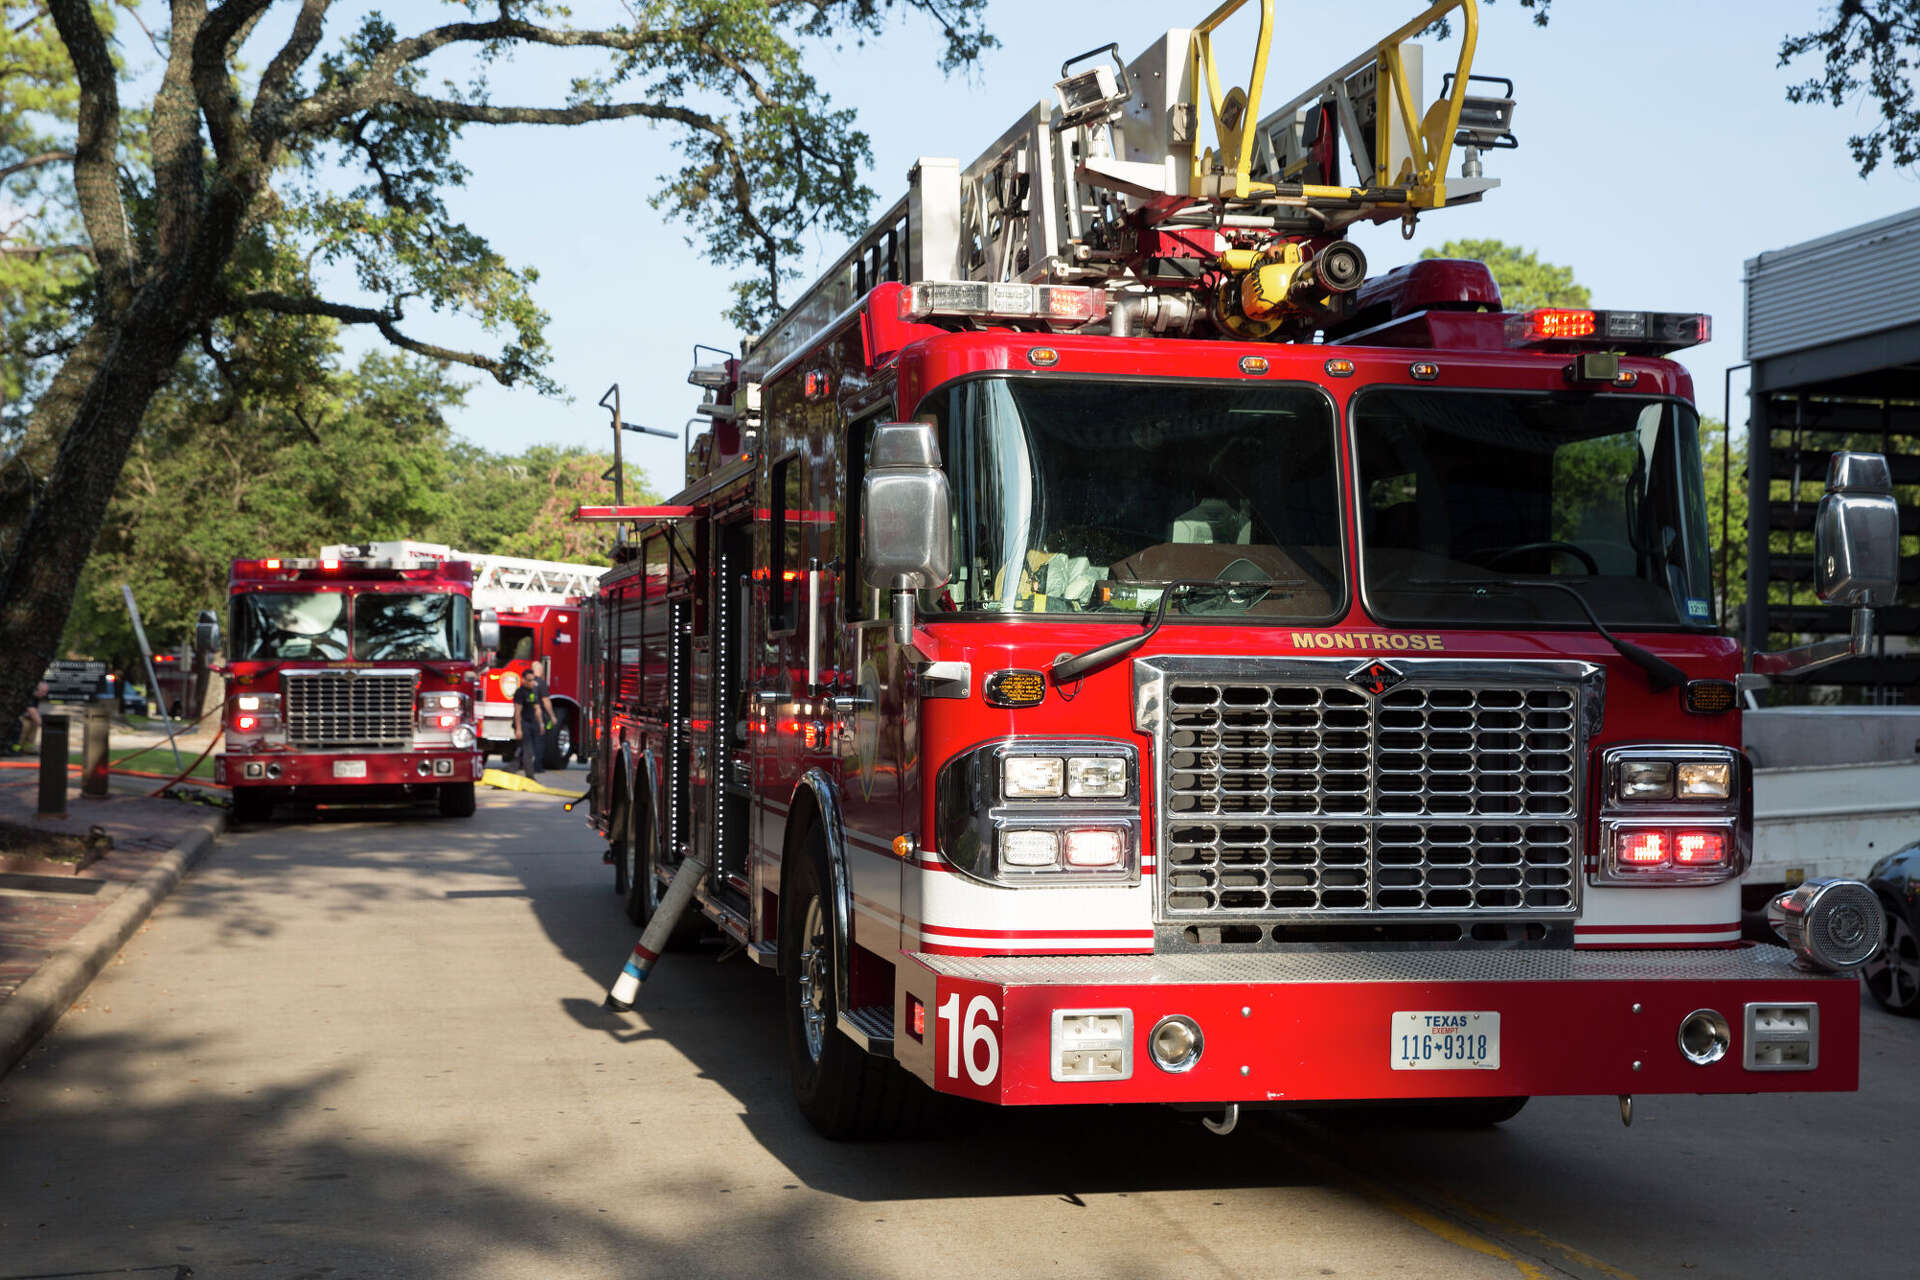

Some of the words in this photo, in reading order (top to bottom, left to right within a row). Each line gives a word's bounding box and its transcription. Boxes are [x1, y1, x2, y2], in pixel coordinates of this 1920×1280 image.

[1290, 632, 1445, 650] MONTROSE
[1424, 1015, 1468, 1027] TEXAS
[938, 992, 999, 1086] 16
